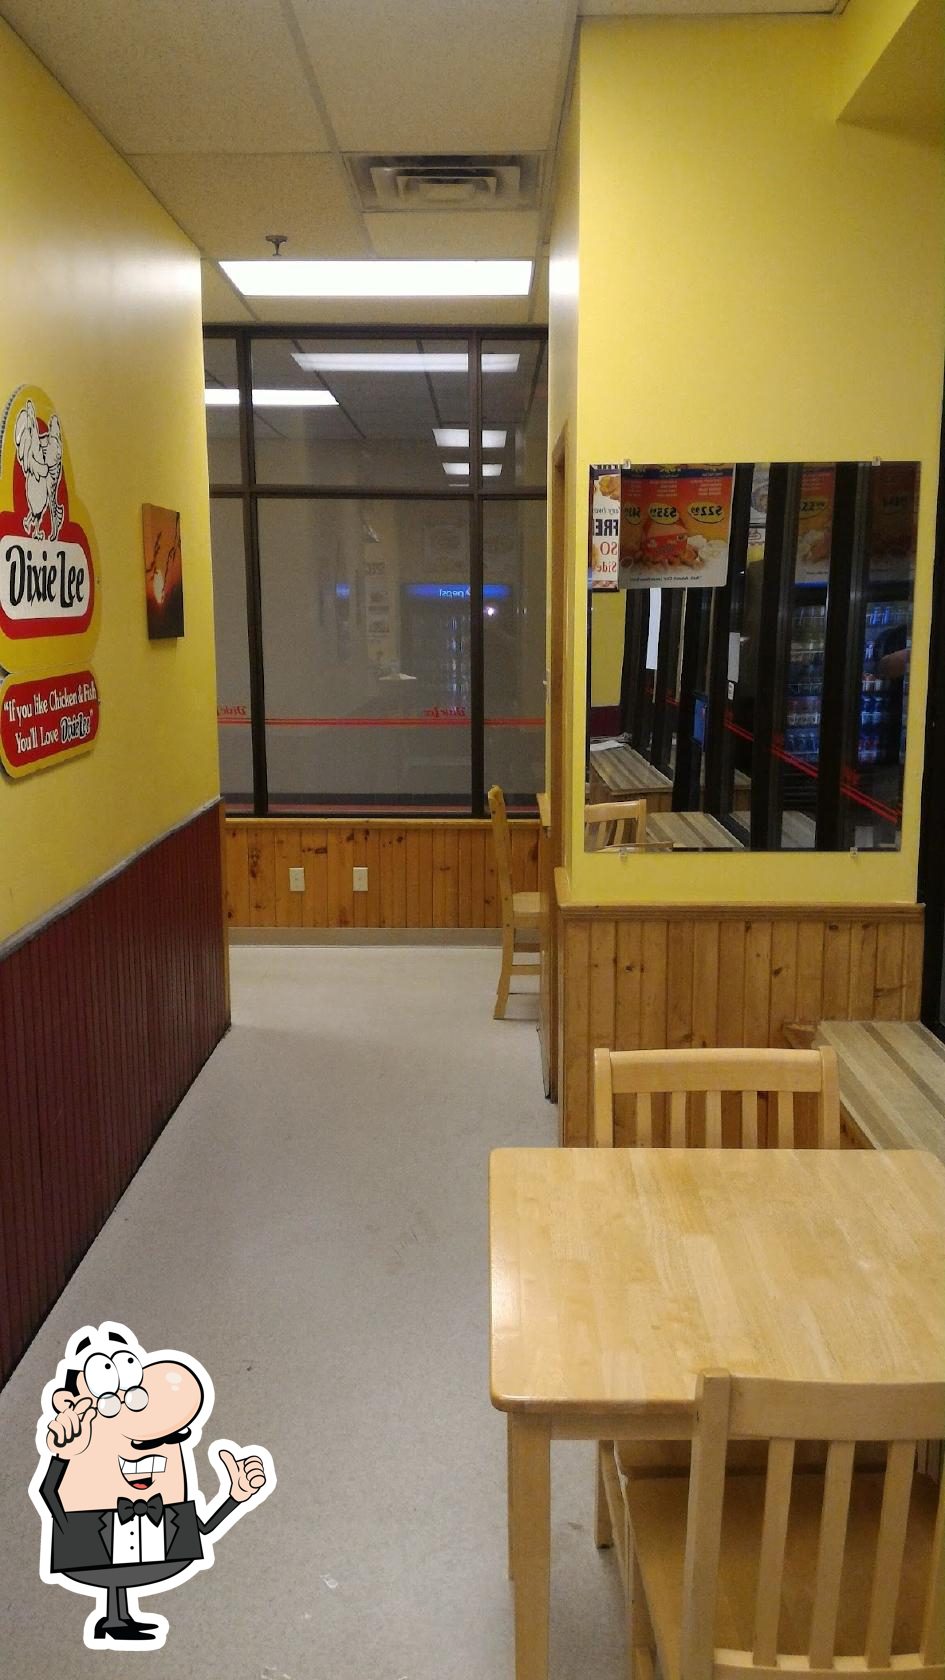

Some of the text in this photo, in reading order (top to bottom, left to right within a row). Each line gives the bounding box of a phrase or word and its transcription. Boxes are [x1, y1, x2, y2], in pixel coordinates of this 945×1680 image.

[6, 545, 84, 608] Dixie Lee
[16, 703, 33, 727] you
[33, 693, 49, 716] like
[49, 687, 78, 712] Chicken
[77, 684, 83, 703] &
[82, 681, 96, 702] Fish
[40, 726, 59, 747] Love
